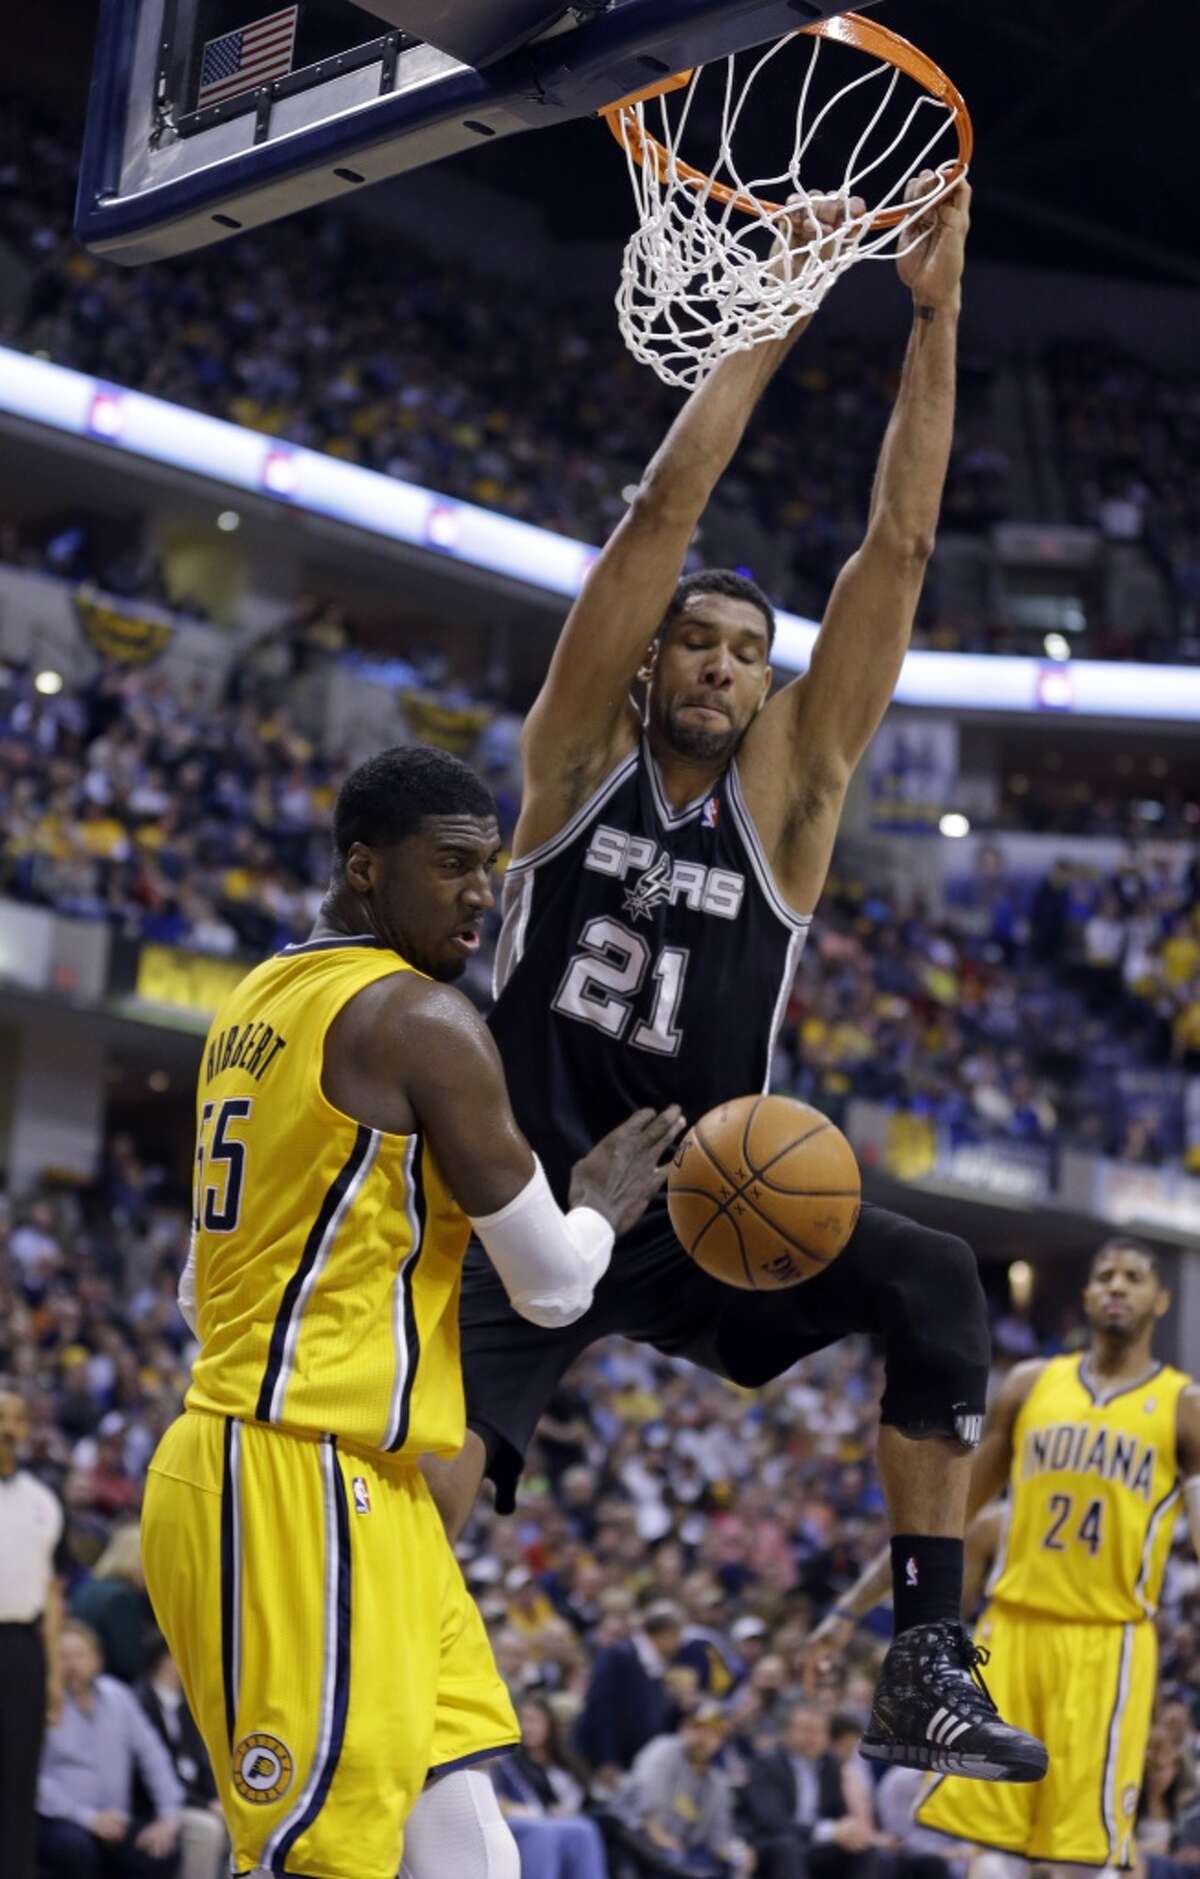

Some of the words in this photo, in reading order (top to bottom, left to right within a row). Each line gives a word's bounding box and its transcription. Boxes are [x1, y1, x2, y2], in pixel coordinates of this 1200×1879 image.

[550, 914, 690, 1057] 21
[1021, 1424, 1156, 1500] INDIANA
[1042, 1493, 1105, 1557] 24
